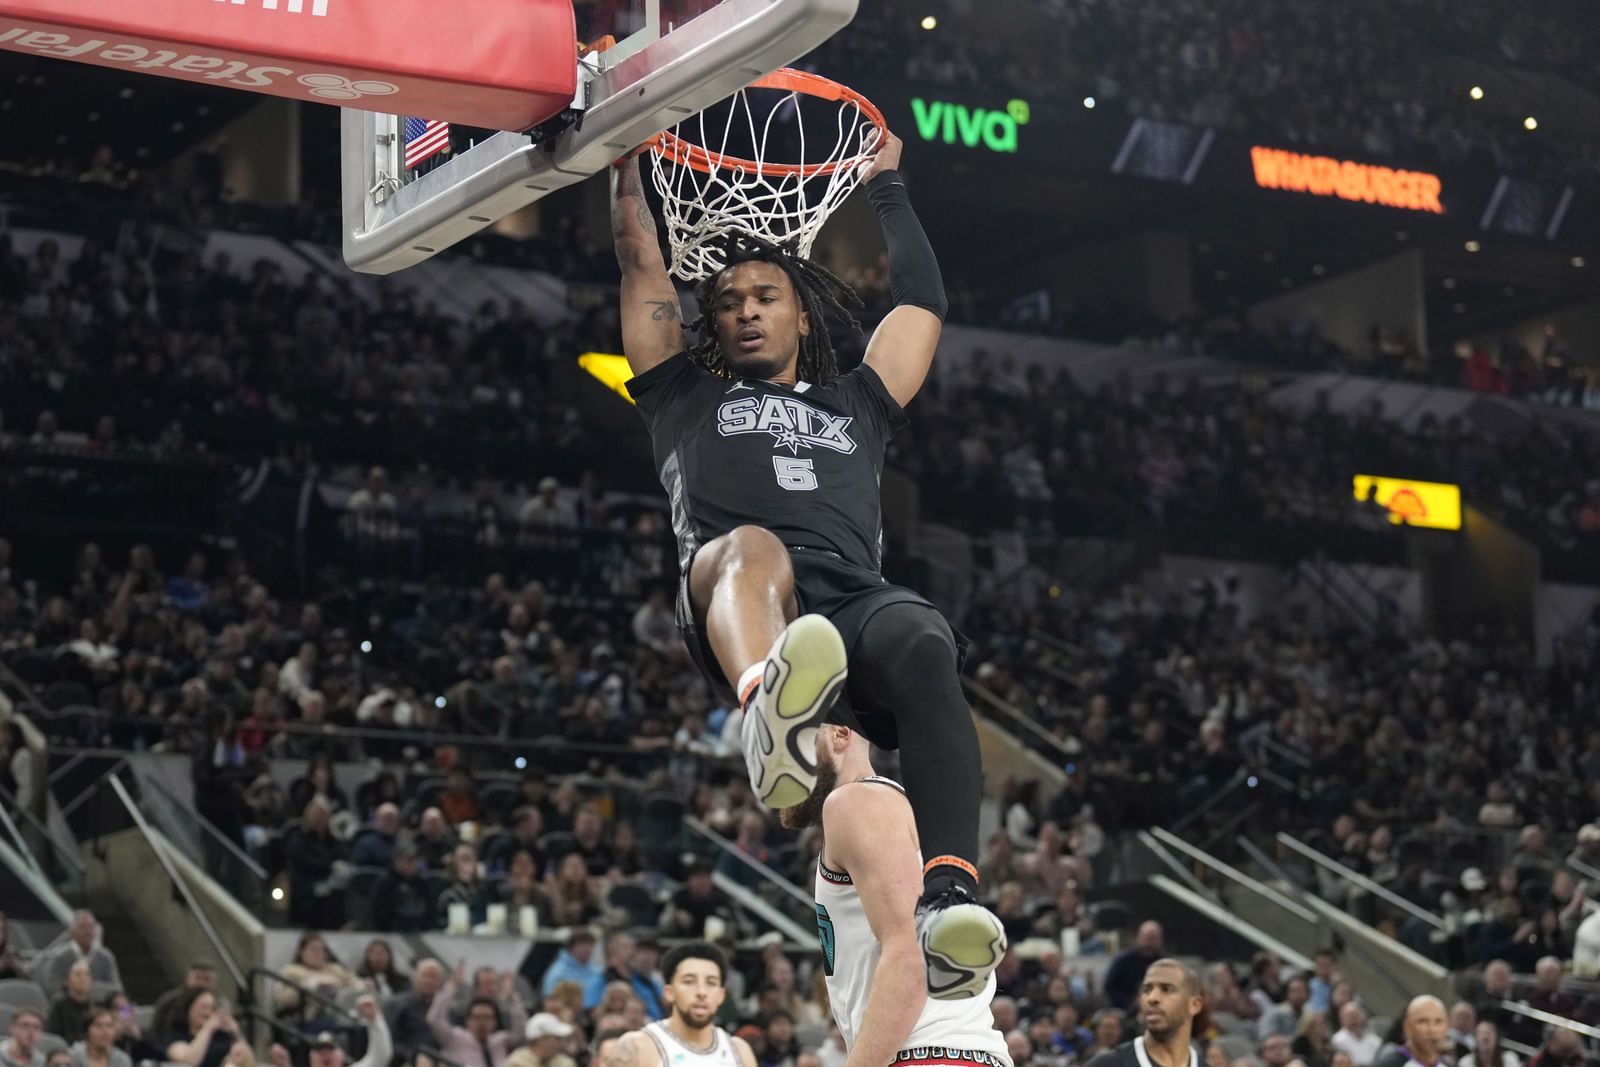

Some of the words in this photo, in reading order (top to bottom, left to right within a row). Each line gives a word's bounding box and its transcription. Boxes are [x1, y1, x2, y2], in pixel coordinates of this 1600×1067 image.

[1250, 146, 1444, 214] WHATABURGER
[717, 394, 857, 455] SATX
[772, 455, 819, 491] 5
